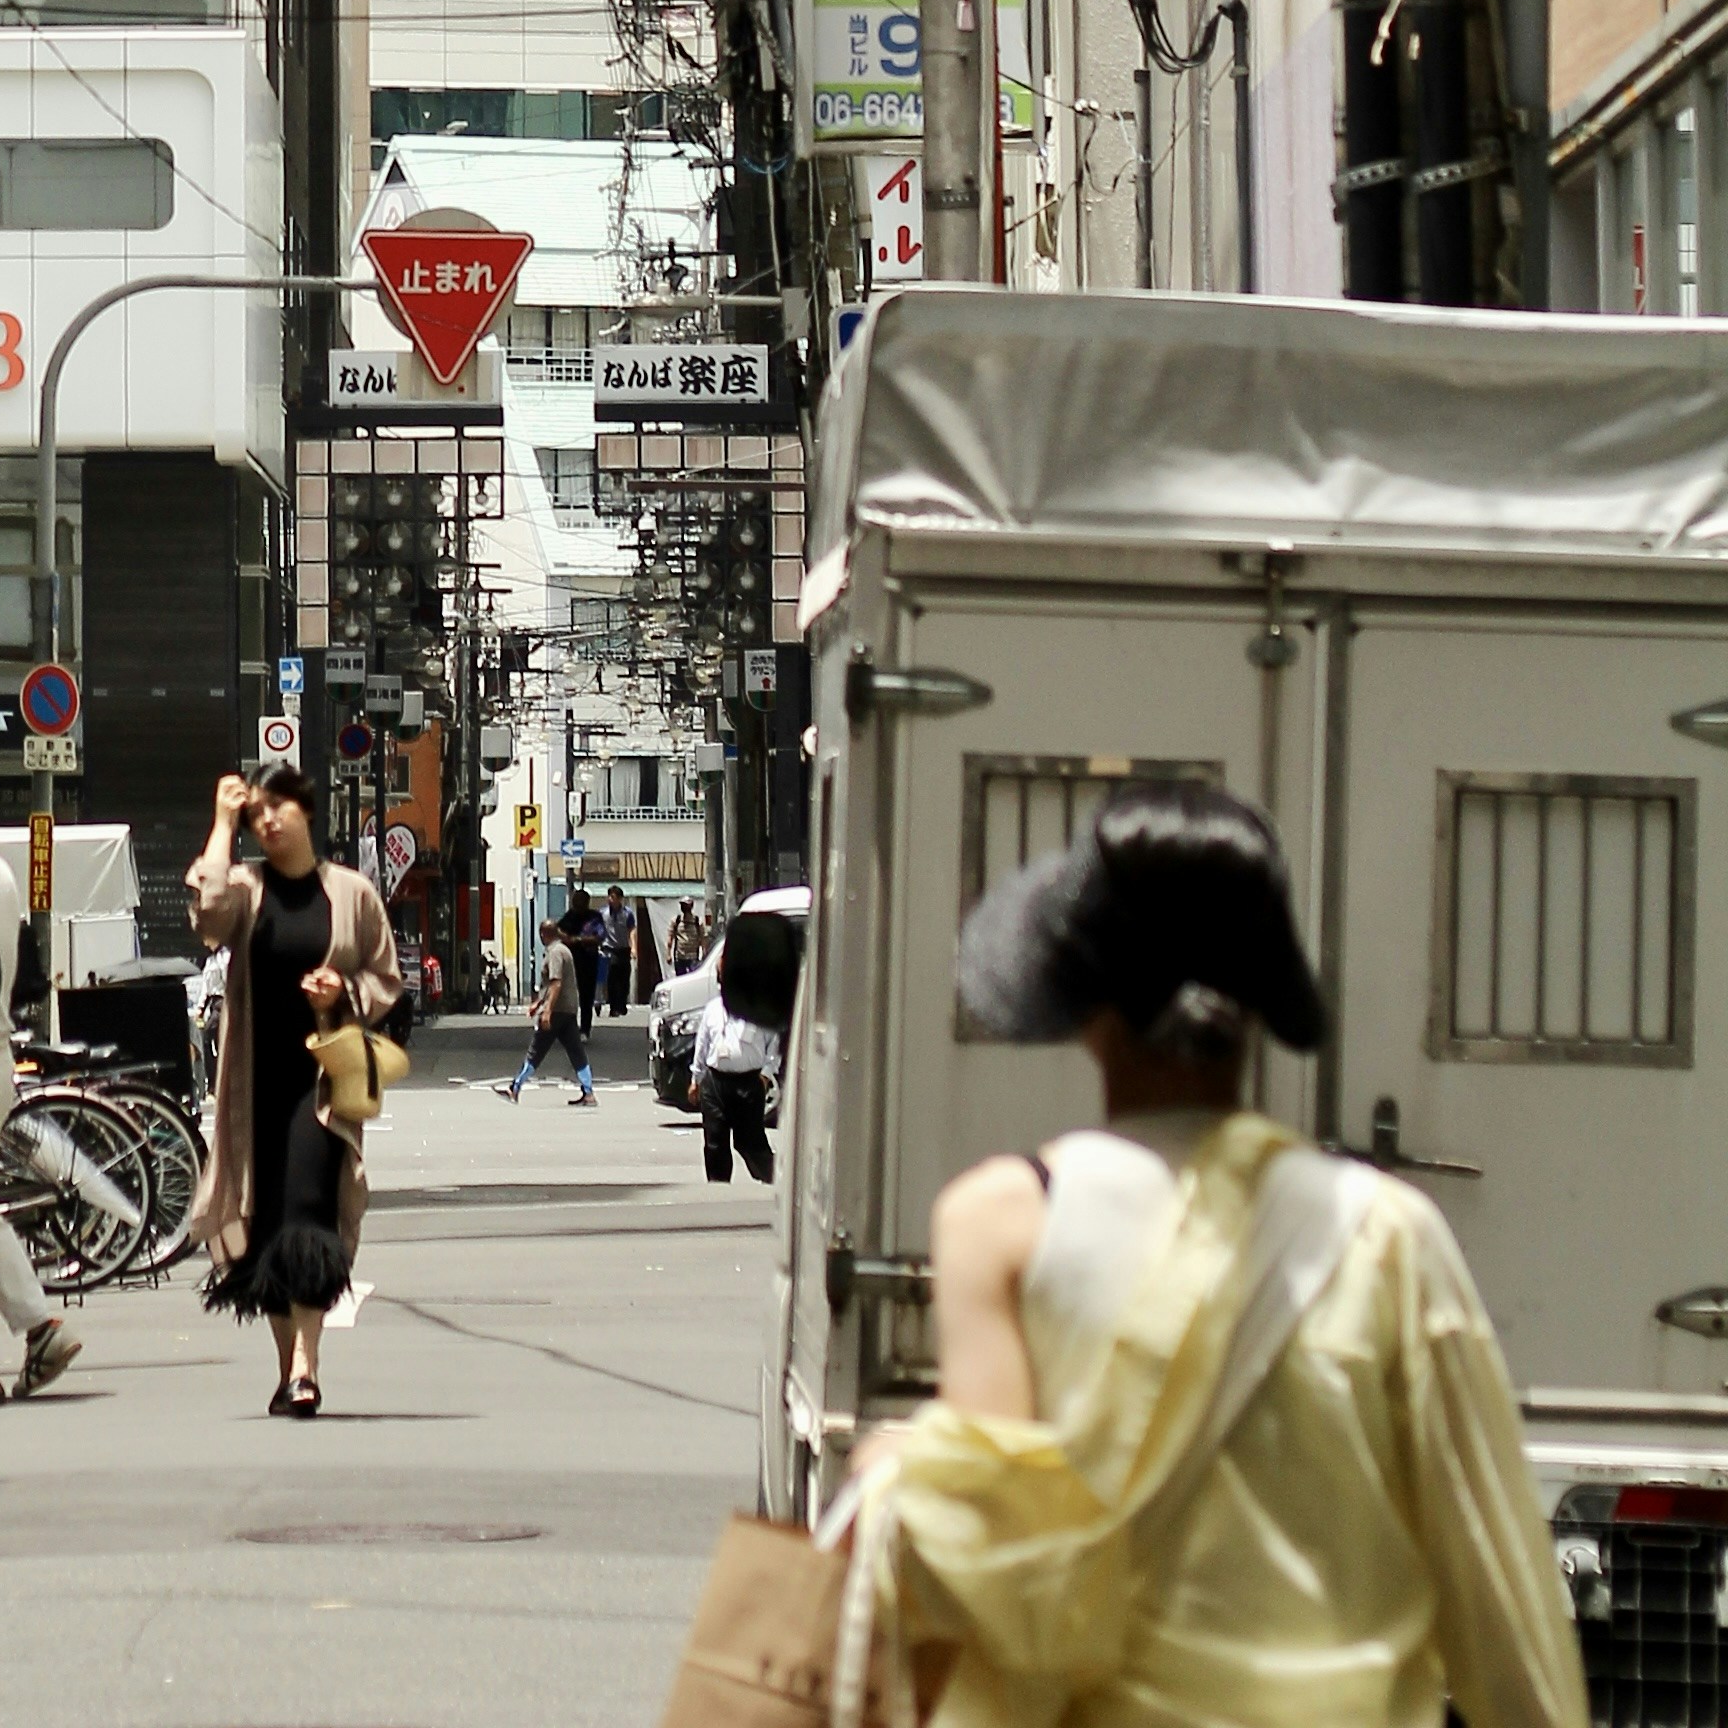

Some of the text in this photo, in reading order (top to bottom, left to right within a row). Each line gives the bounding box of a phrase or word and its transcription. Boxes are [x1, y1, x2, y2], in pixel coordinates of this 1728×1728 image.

[398, 259, 498, 297] 止まれ
[271, 730, 288, 743] 30
[519, 805, 537, 827] P
